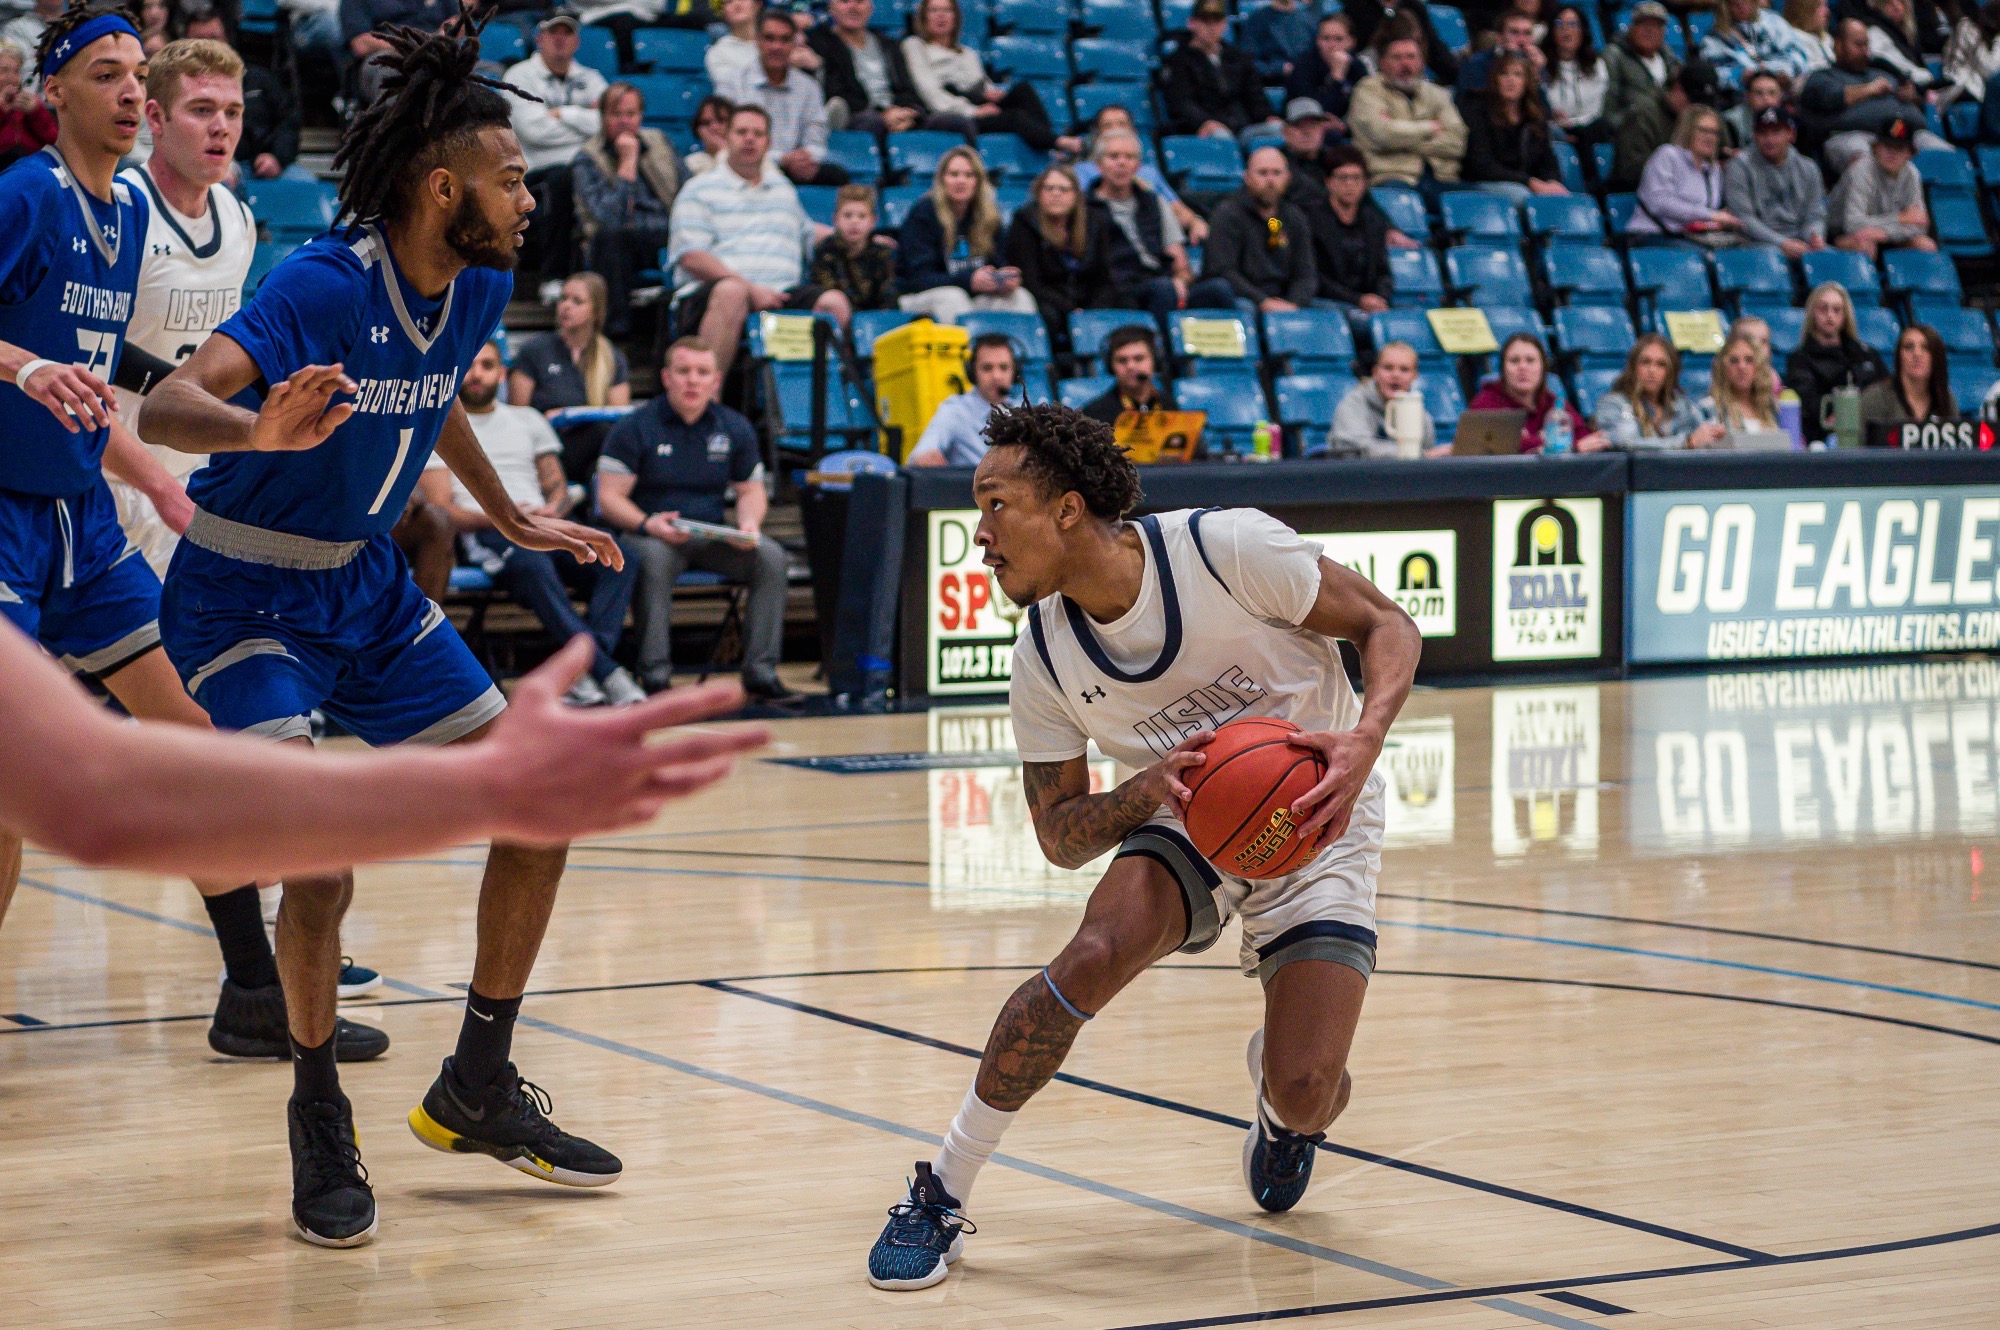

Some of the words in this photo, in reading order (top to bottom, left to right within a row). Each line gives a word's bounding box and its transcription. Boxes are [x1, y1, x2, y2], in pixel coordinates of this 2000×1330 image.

[367, 427, 414, 515] 1
[1901, 422, 1974, 451] POSS
[1509, 572, 1587, 609] KOAL
[1656, 502, 1757, 615] GO
[1775, 497, 2000, 610] EAGLE
[1133, 664, 1268, 760] USUE
